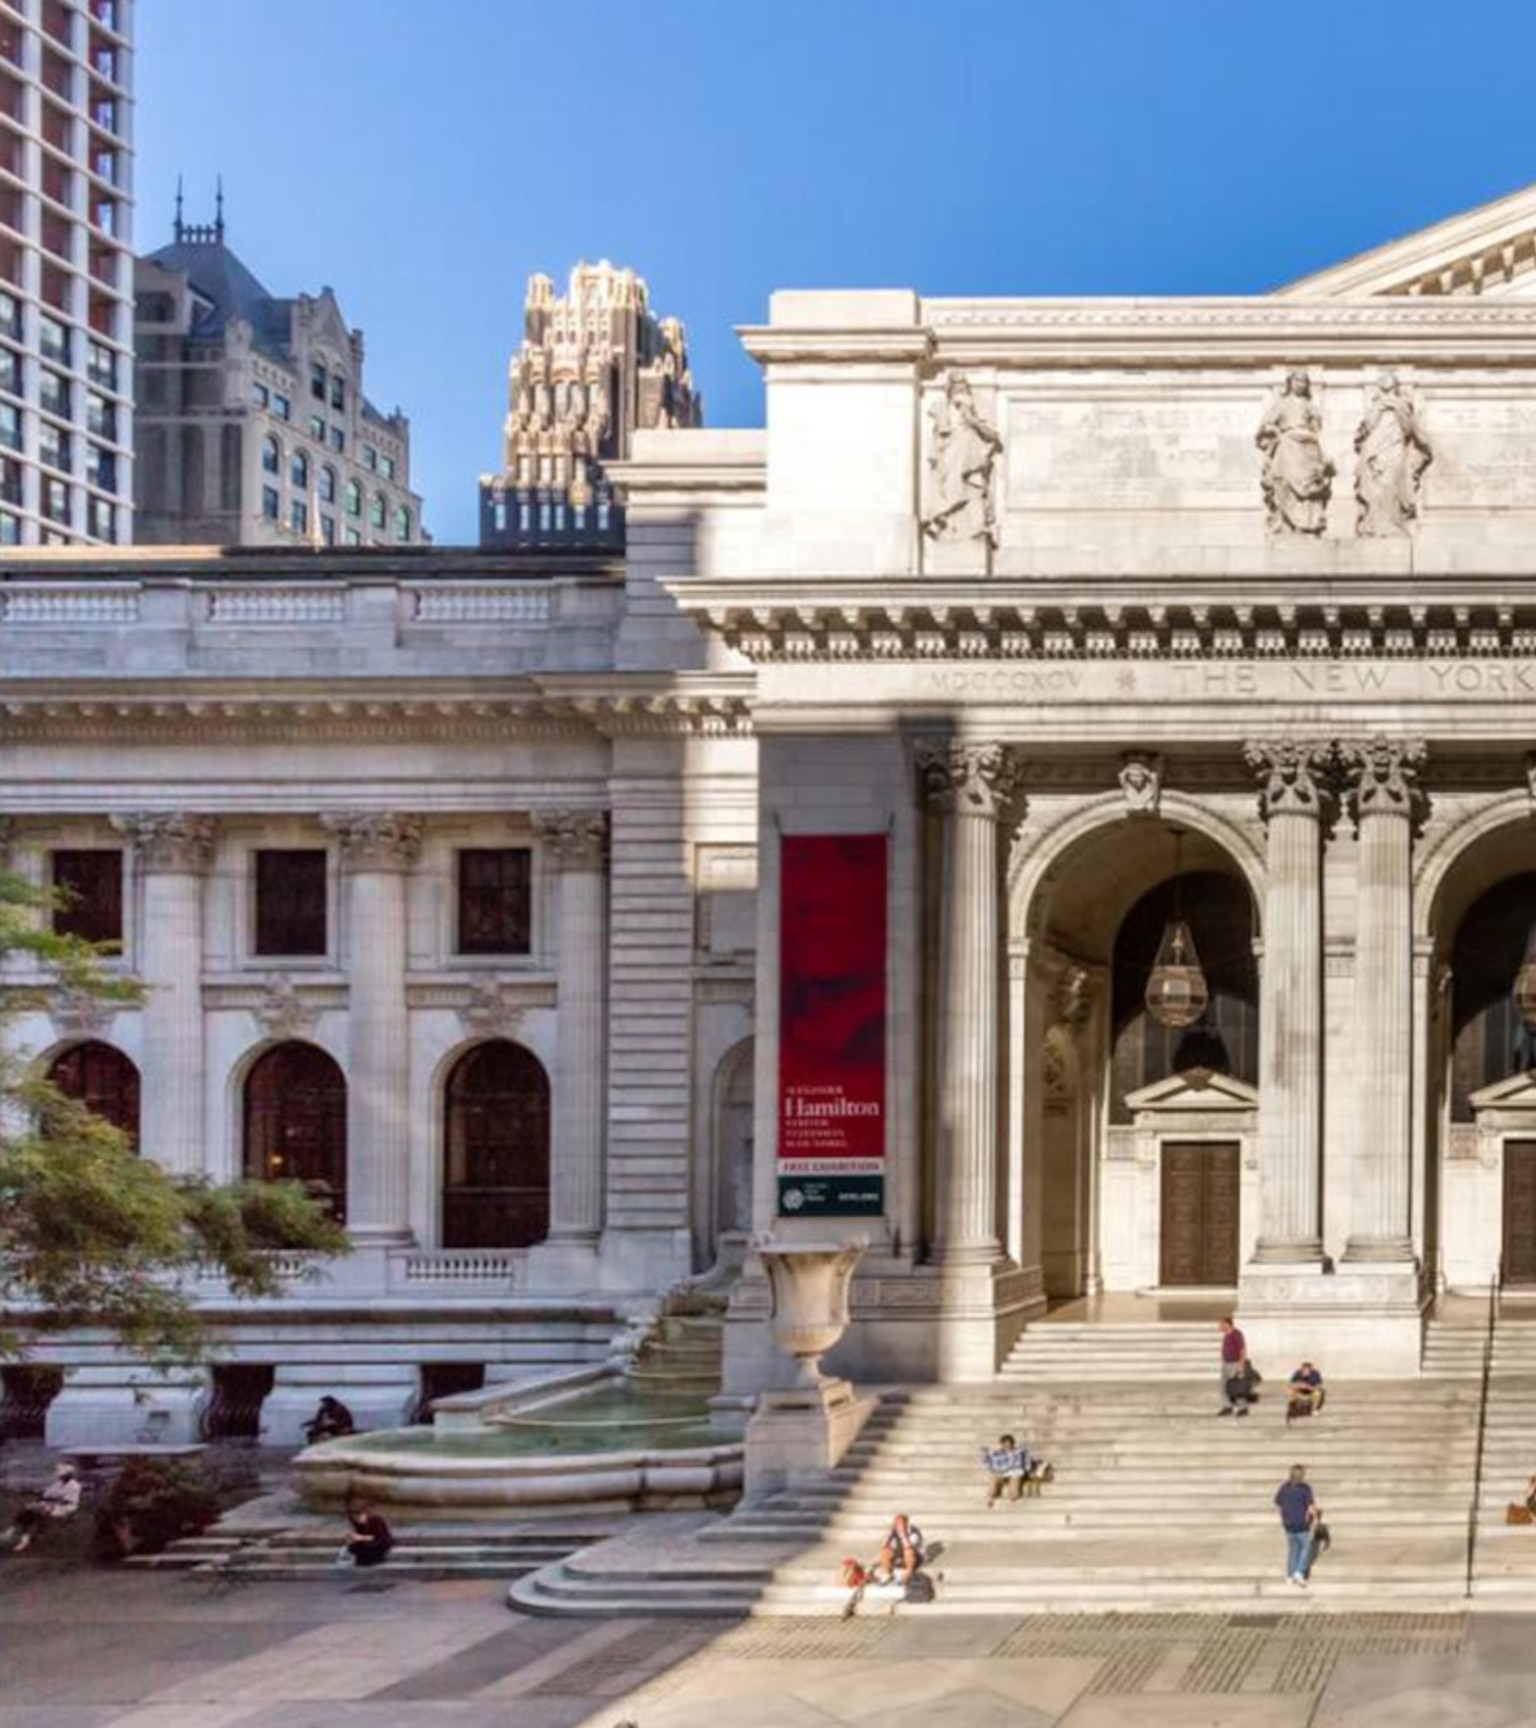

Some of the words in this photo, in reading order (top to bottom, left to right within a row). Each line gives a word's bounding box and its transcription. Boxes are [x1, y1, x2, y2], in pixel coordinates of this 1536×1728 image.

[1171, 664, 1256, 694] THE
[1290, 664, 1392, 693] NEW
[784, 1097, 880, 1117] Hamilton
